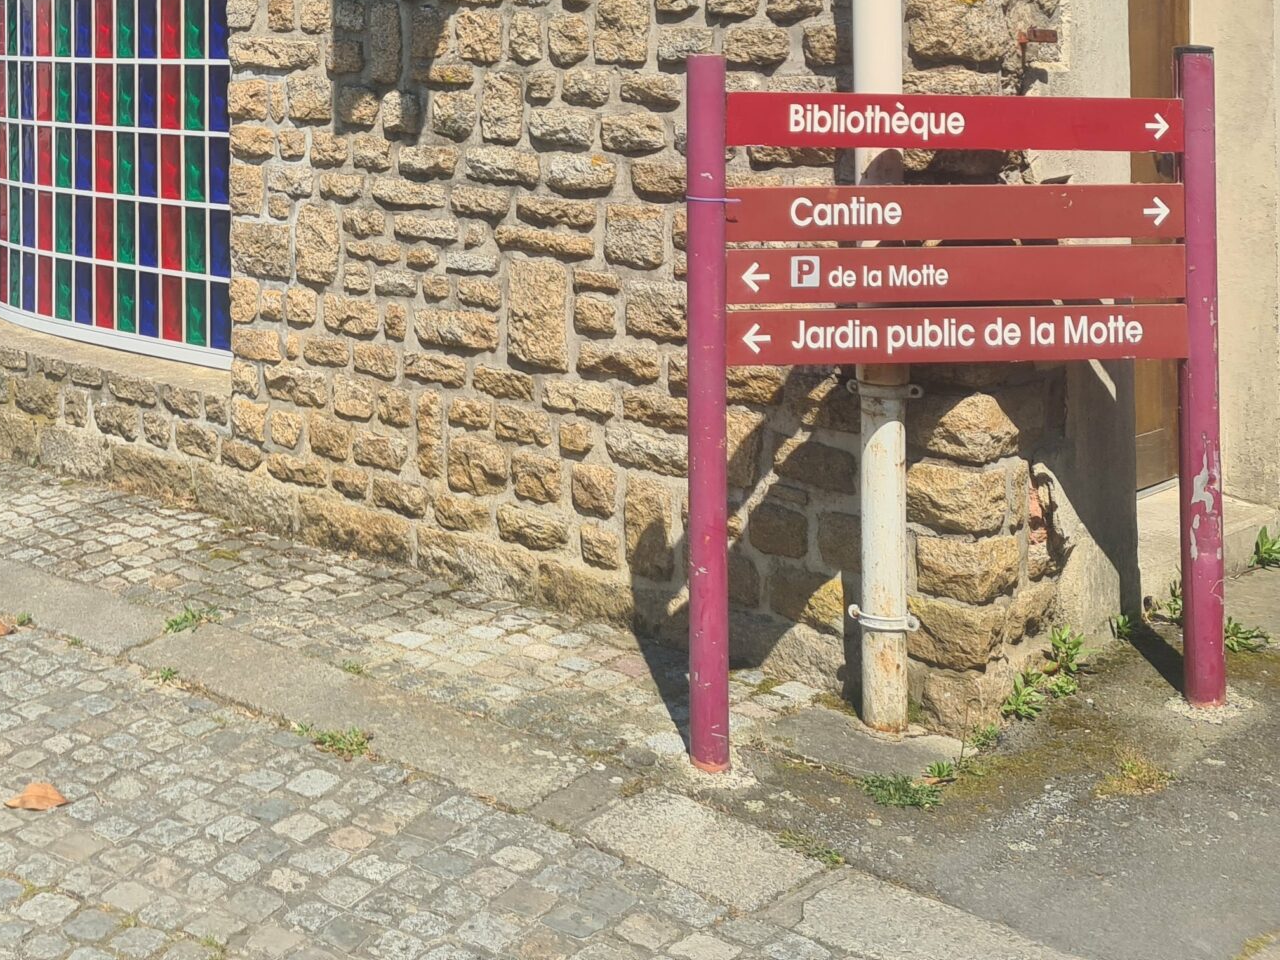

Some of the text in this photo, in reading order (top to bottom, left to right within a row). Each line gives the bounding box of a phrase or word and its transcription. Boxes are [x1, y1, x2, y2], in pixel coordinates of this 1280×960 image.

[789, 101, 965, 141] Bibliothèque
[790, 196, 903, 227] Cantine
[828, 265, 857, 287] de
[862, 265, 882, 287] la
[888, 264, 949, 287] Motte
[791, 315, 1143, 355] Jardin public de la Motte
